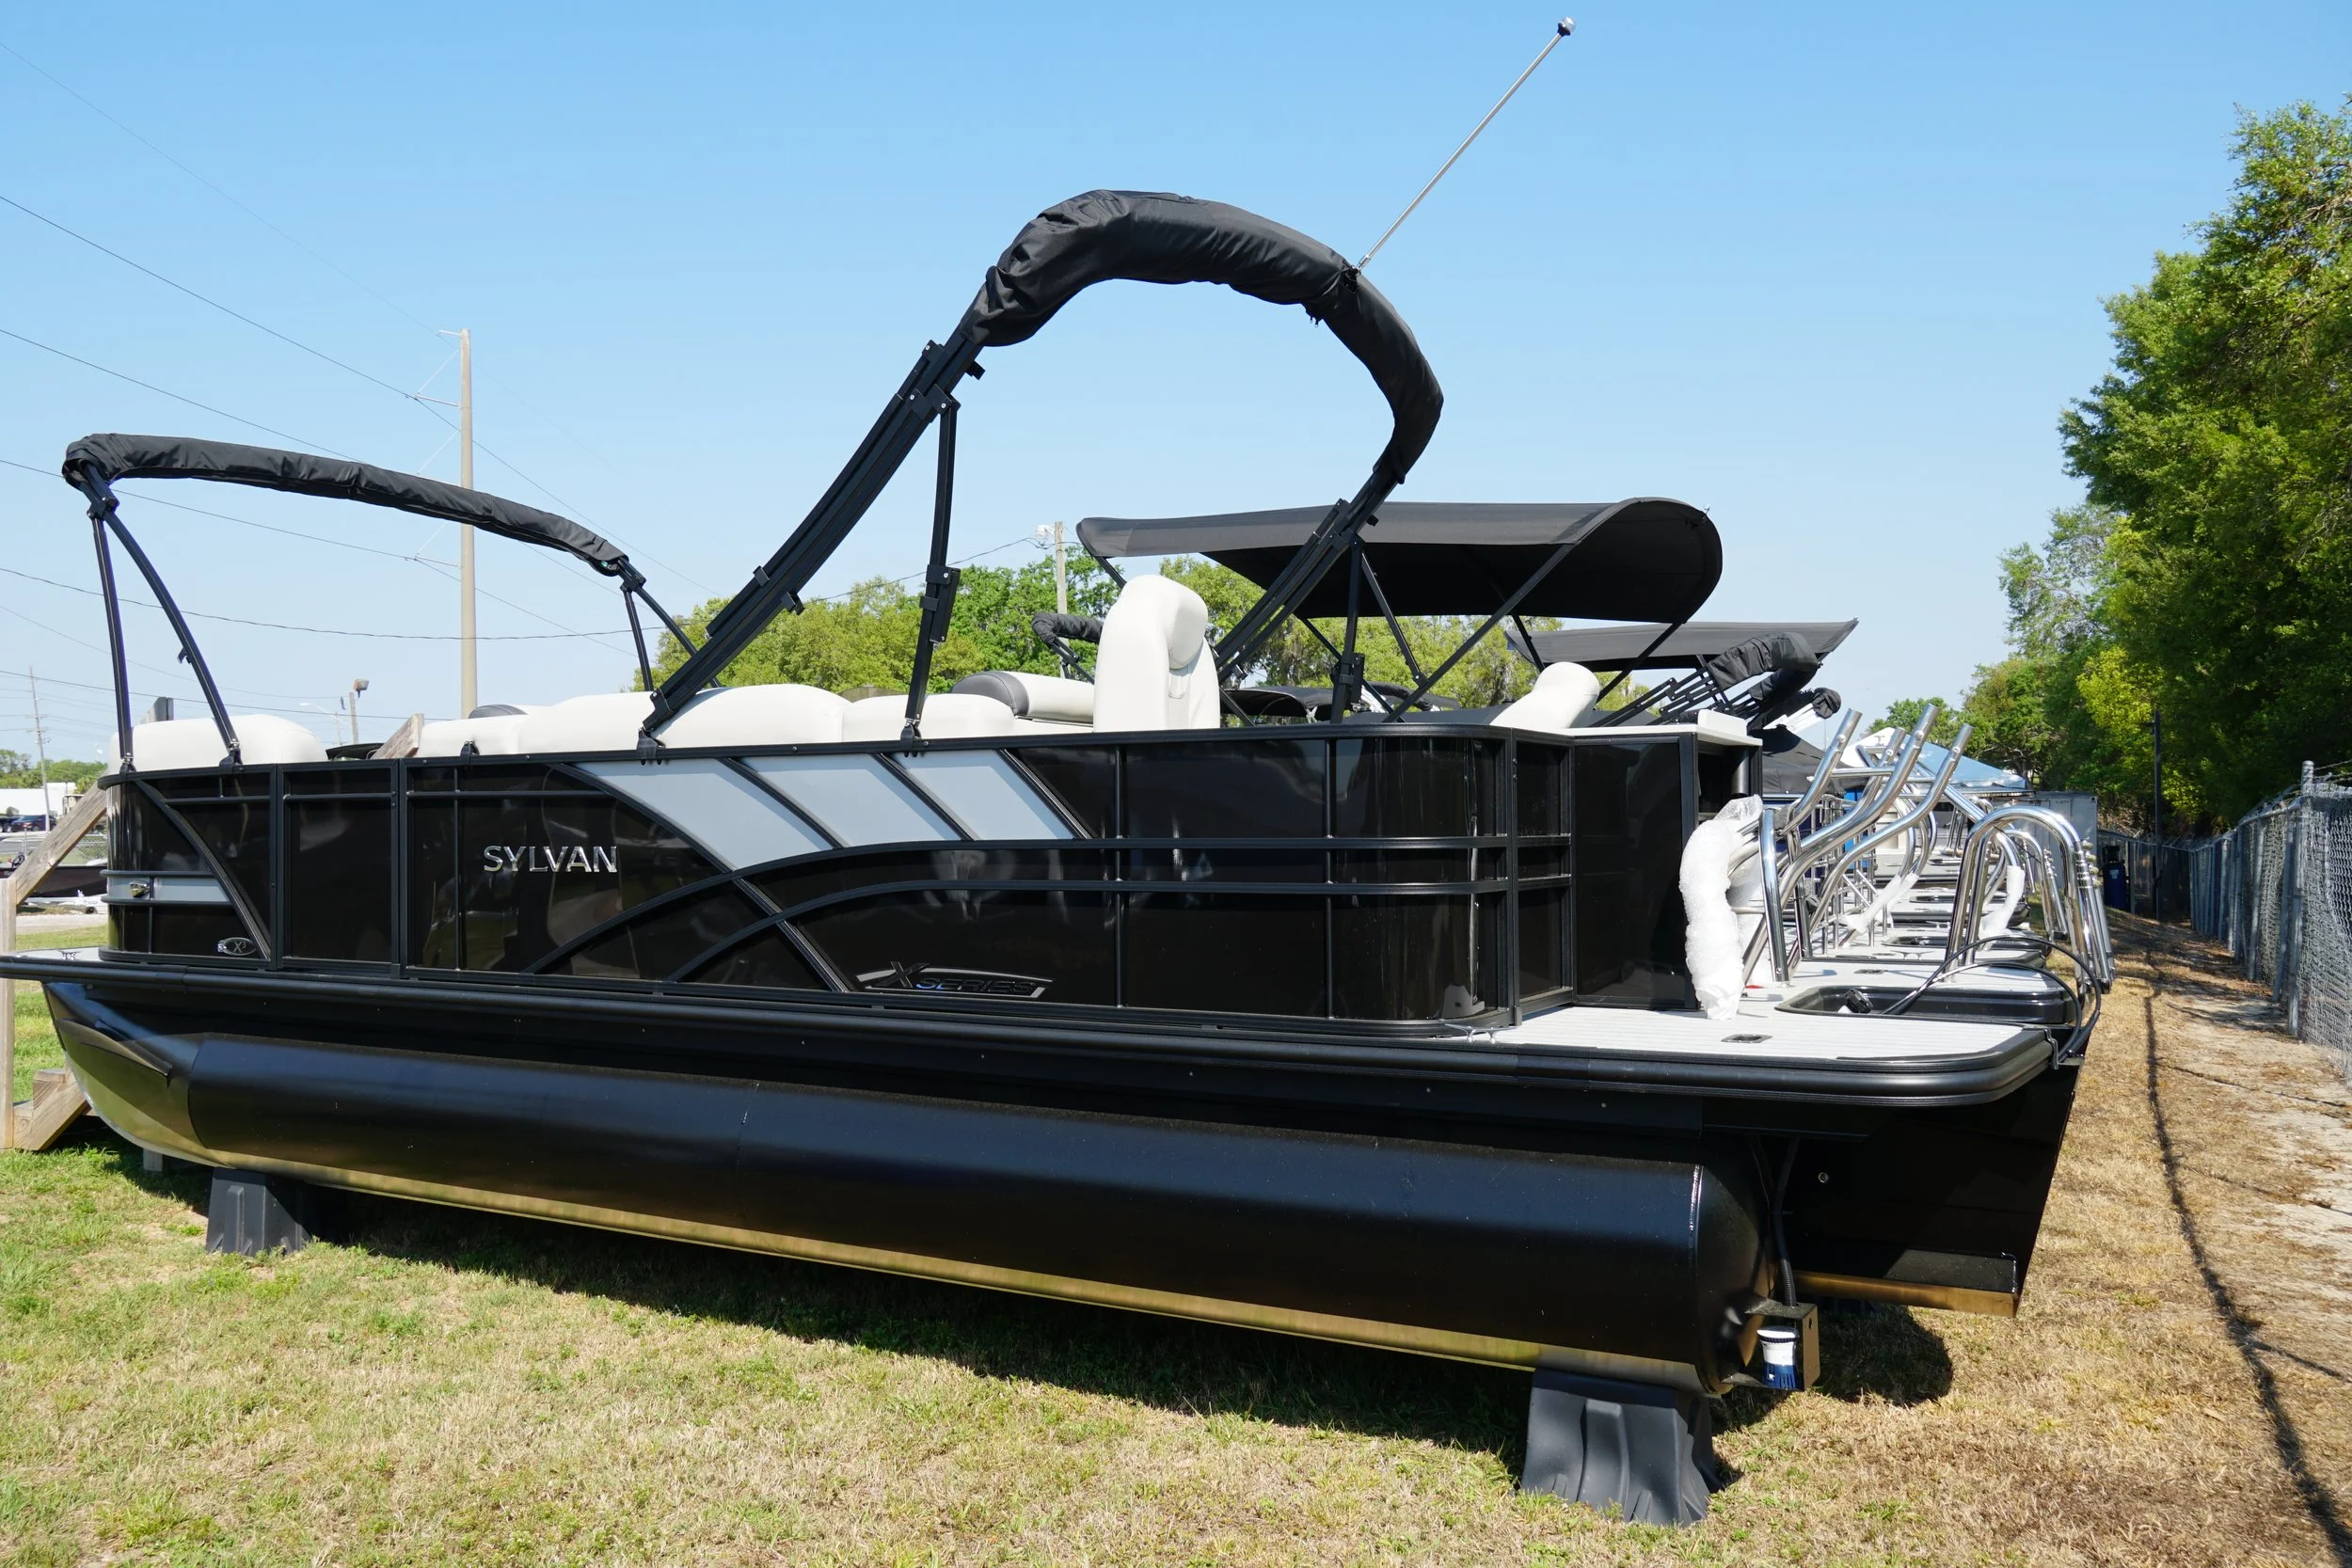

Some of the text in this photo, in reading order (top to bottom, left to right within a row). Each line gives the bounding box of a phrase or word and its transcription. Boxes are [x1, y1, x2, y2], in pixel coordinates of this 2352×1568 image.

[483, 845, 618, 873] SYLVAN
[875, 960, 1037, 993] X SERIES
